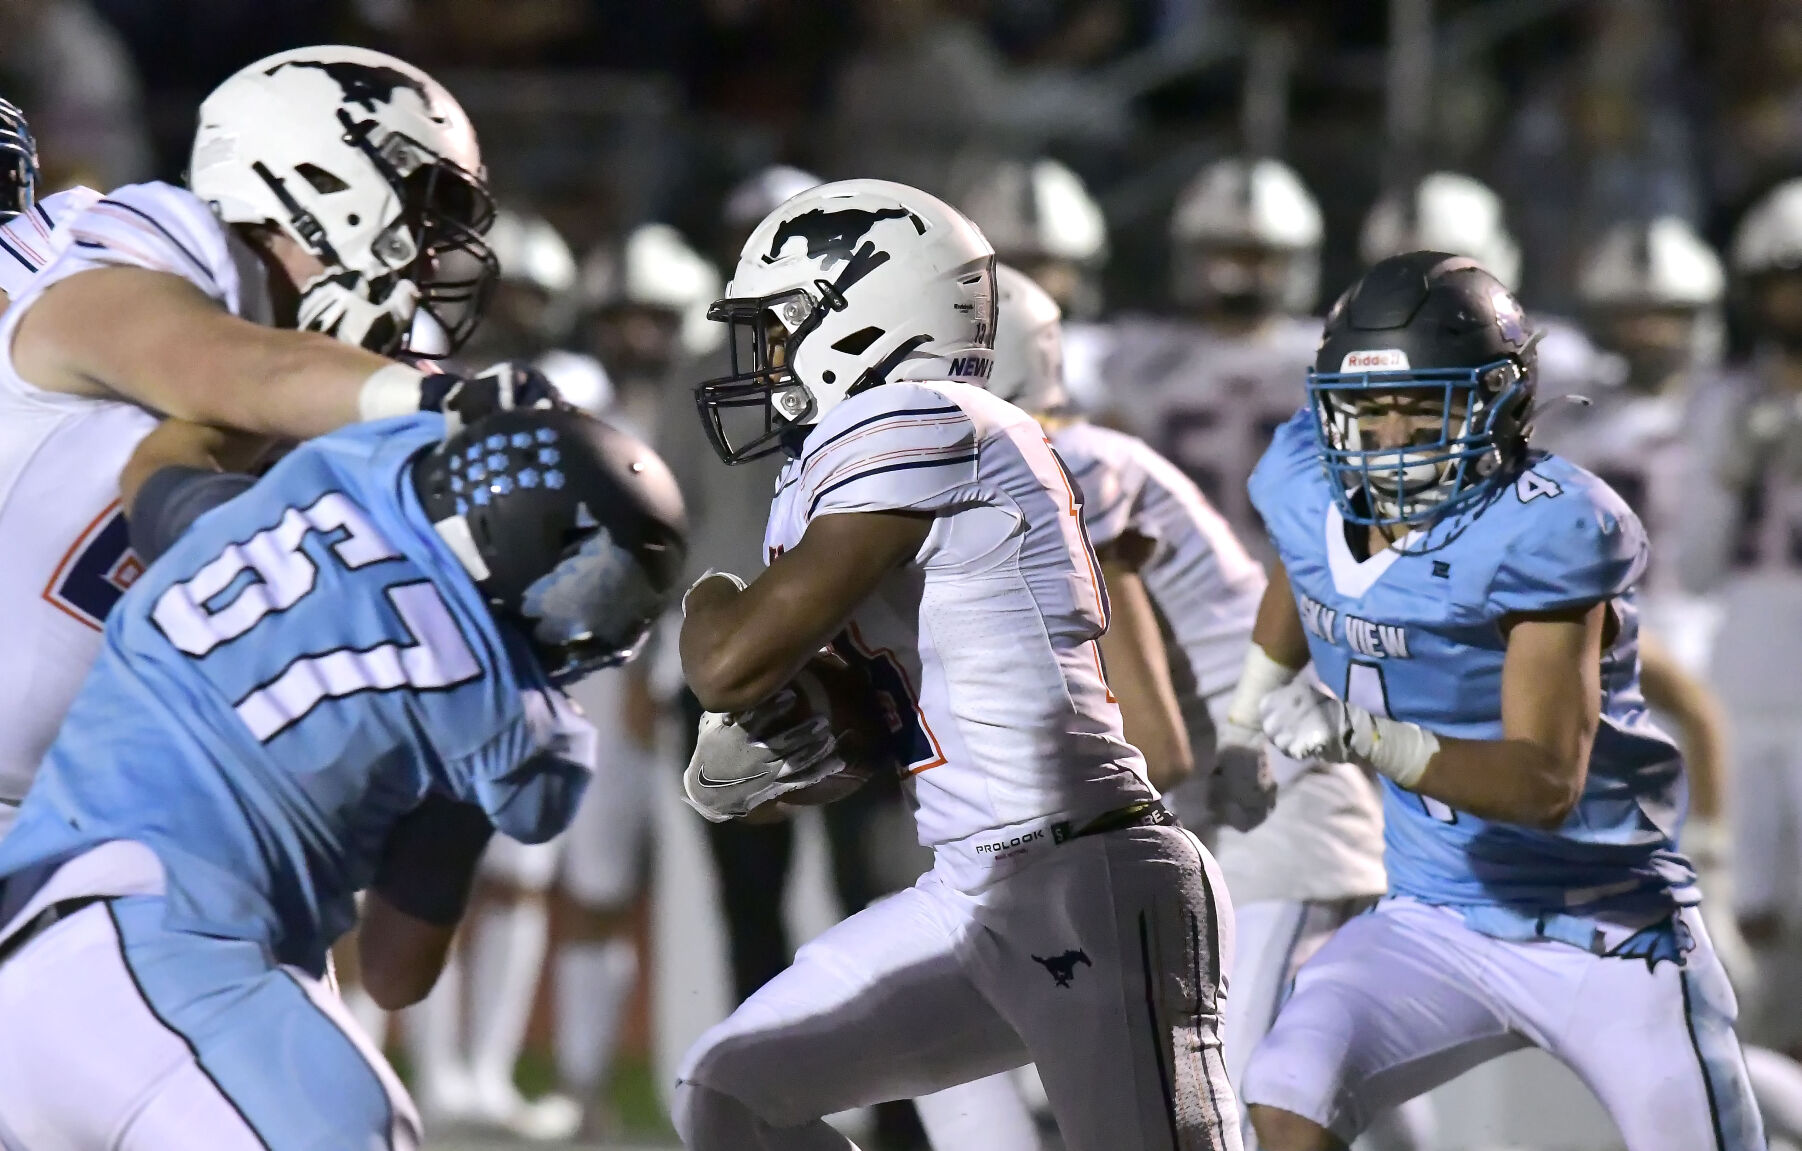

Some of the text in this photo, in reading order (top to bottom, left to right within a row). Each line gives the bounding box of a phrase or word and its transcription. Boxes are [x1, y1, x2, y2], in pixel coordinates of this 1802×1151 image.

[948, 357, 990, 377] NEW
[1515, 469, 1563, 504] 4
[149, 489, 486, 744] 67
[1344, 613, 1412, 659] VIEW
[975, 829, 1045, 854] PROLOOK
